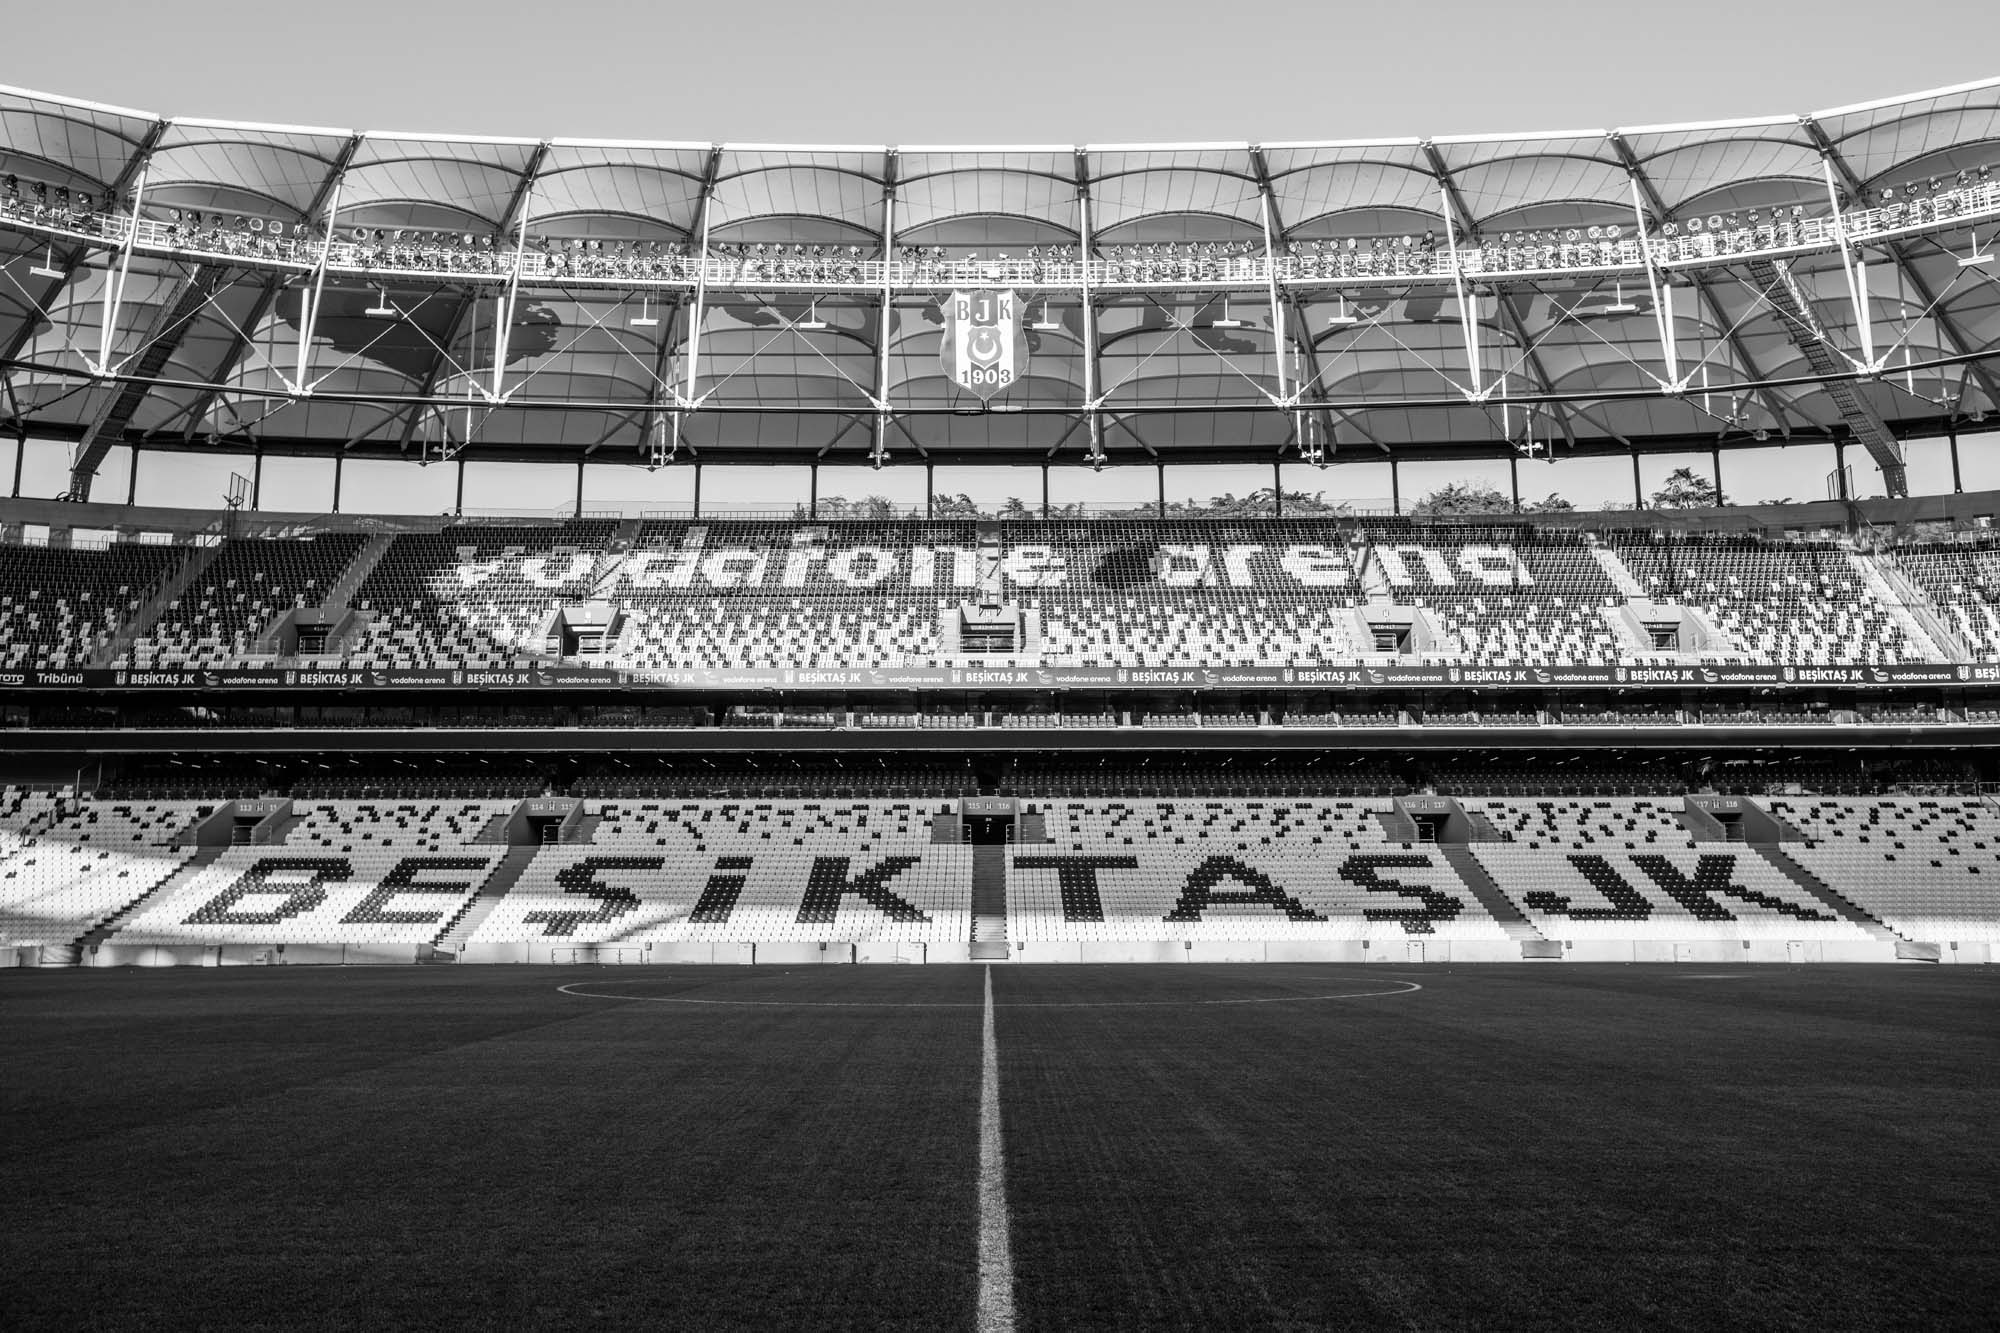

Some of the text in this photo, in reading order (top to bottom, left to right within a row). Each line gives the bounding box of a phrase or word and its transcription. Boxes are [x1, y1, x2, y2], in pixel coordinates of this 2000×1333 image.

[957, 299, 1011, 322] BJK
[961, 369, 1011, 385] 1903
[1157, 542, 1534, 588] arena
[37, 672, 84, 684] Tribünü
[131, 671, 195, 686] BEŞİKTAŞ JK
[223, 676, 257, 684] vodafone
[300, 671, 363, 686] BEŞİKTAŞ JK
[390, 676, 424, 684] vodafone
[467, 671, 529, 685] BEŞİKTAŞ JK
[556, 676, 590, 684] vodafone
[632, 670, 695, 685] BEŞİKTAŞ JK
[799, 670, 861, 685] BEŞİKTAŞ JK
[889, 675, 922, 683] vodafone
[966, 670, 1028, 684] BEŞİKTAŞ JK
[1056, 674, 1089, 683] vodafone
[1132, 669, 1195, 684] BEŞİKTAŞ JK
[1222, 674, 1255, 682] vodafone
[1298, 668, 1360, 683] BEŞİKTAŞ JK
[1387, 673, 1421, 682] vodafone
[1464, 668, 1527, 683] BEŞİKTAŞ JK
[1553, 673, 1587, 681] vodafone
[1630, 668, 1694, 683] BEŞİKTAŞ JK
[1721, 673, 1755, 681] vodafone
[1799, 667, 1864, 682] BEŞİKTAŞ JK
[1892, 672, 1928, 680] vodafone
[180, 854, 1838, 936] BEŞİKTAŞ JK
